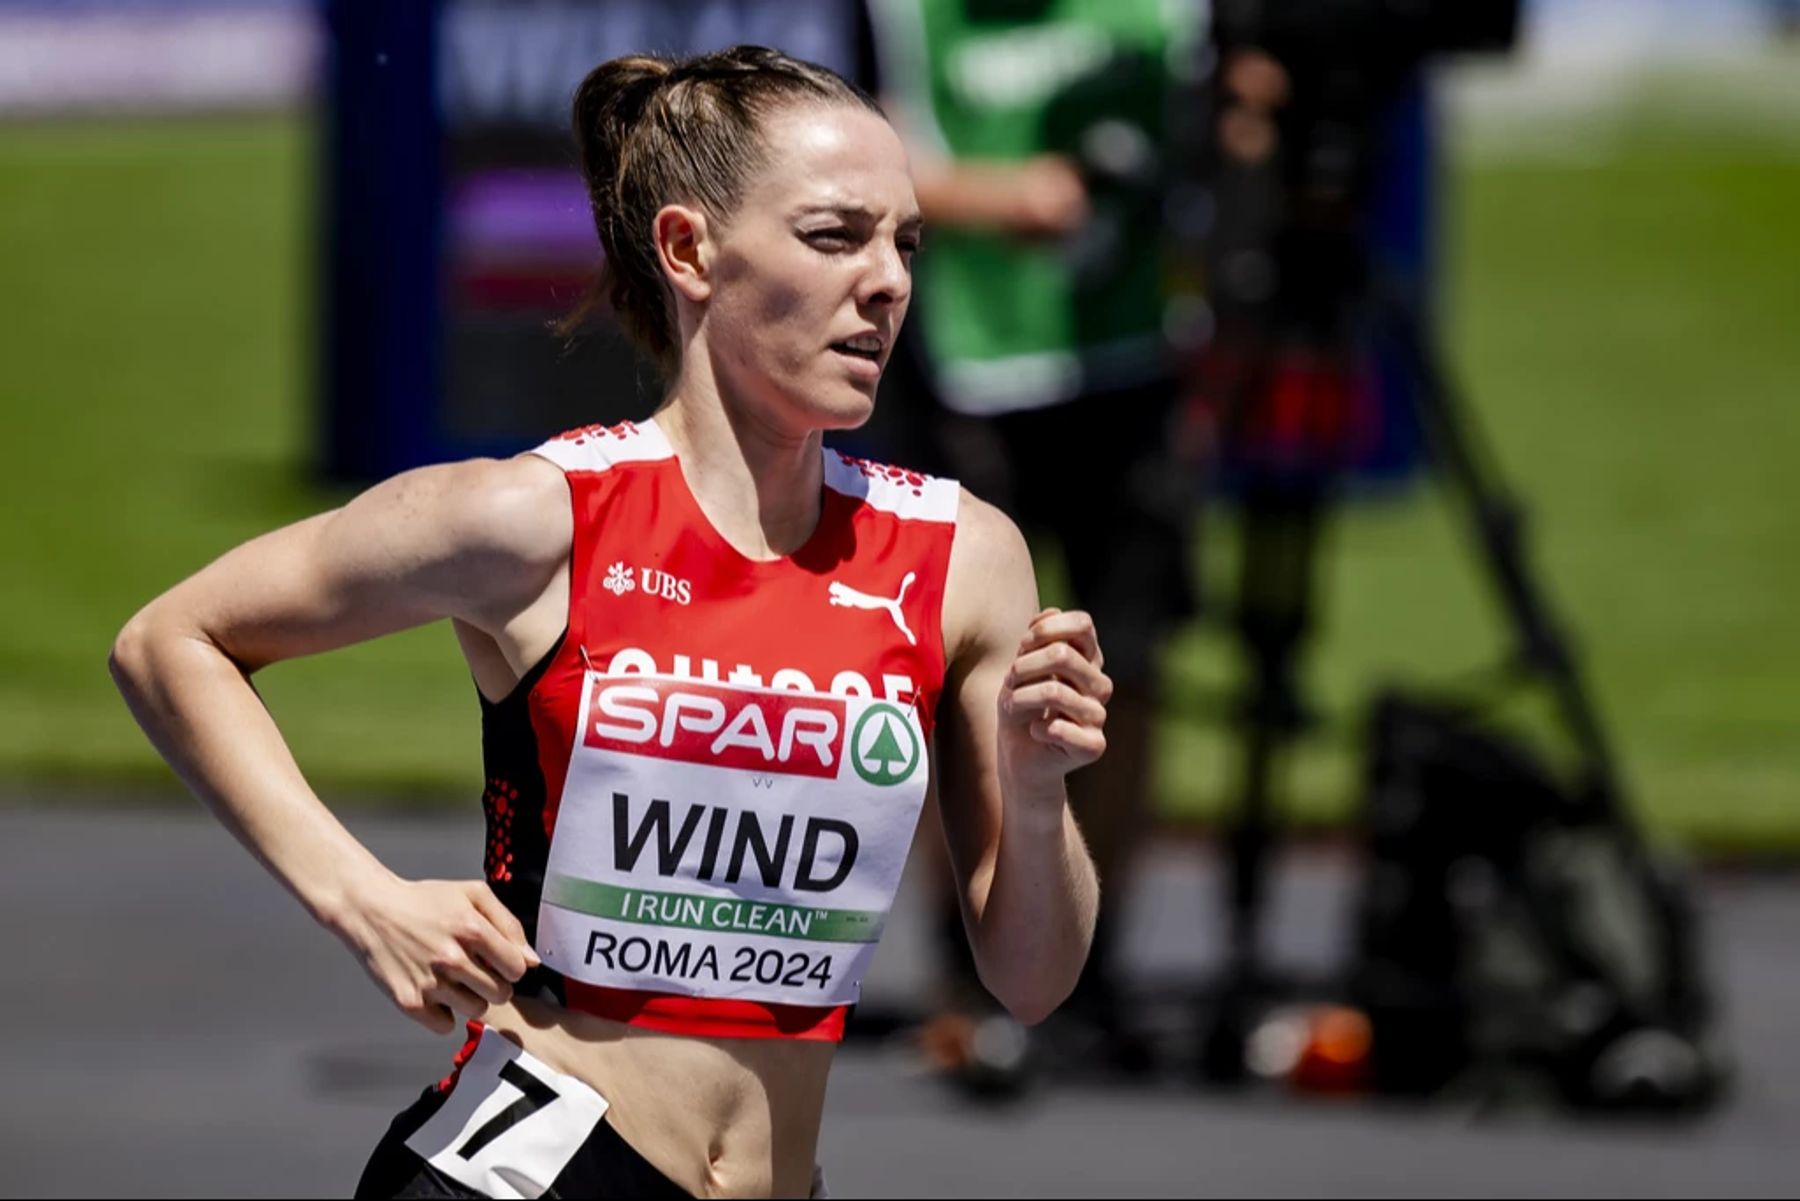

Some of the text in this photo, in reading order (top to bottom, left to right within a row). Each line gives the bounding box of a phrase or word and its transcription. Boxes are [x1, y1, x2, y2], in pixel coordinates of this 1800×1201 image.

[641, 569, 691, 604] UBS
[596, 686, 839, 766] SPAR
[612, 792, 860, 893] WIND
[620, 892, 631, 917] I
[638, 894, 704, 925] RUN
[584, 930, 832, 989] ROMA 2024
[456, 1059, 560, 1162] 7
